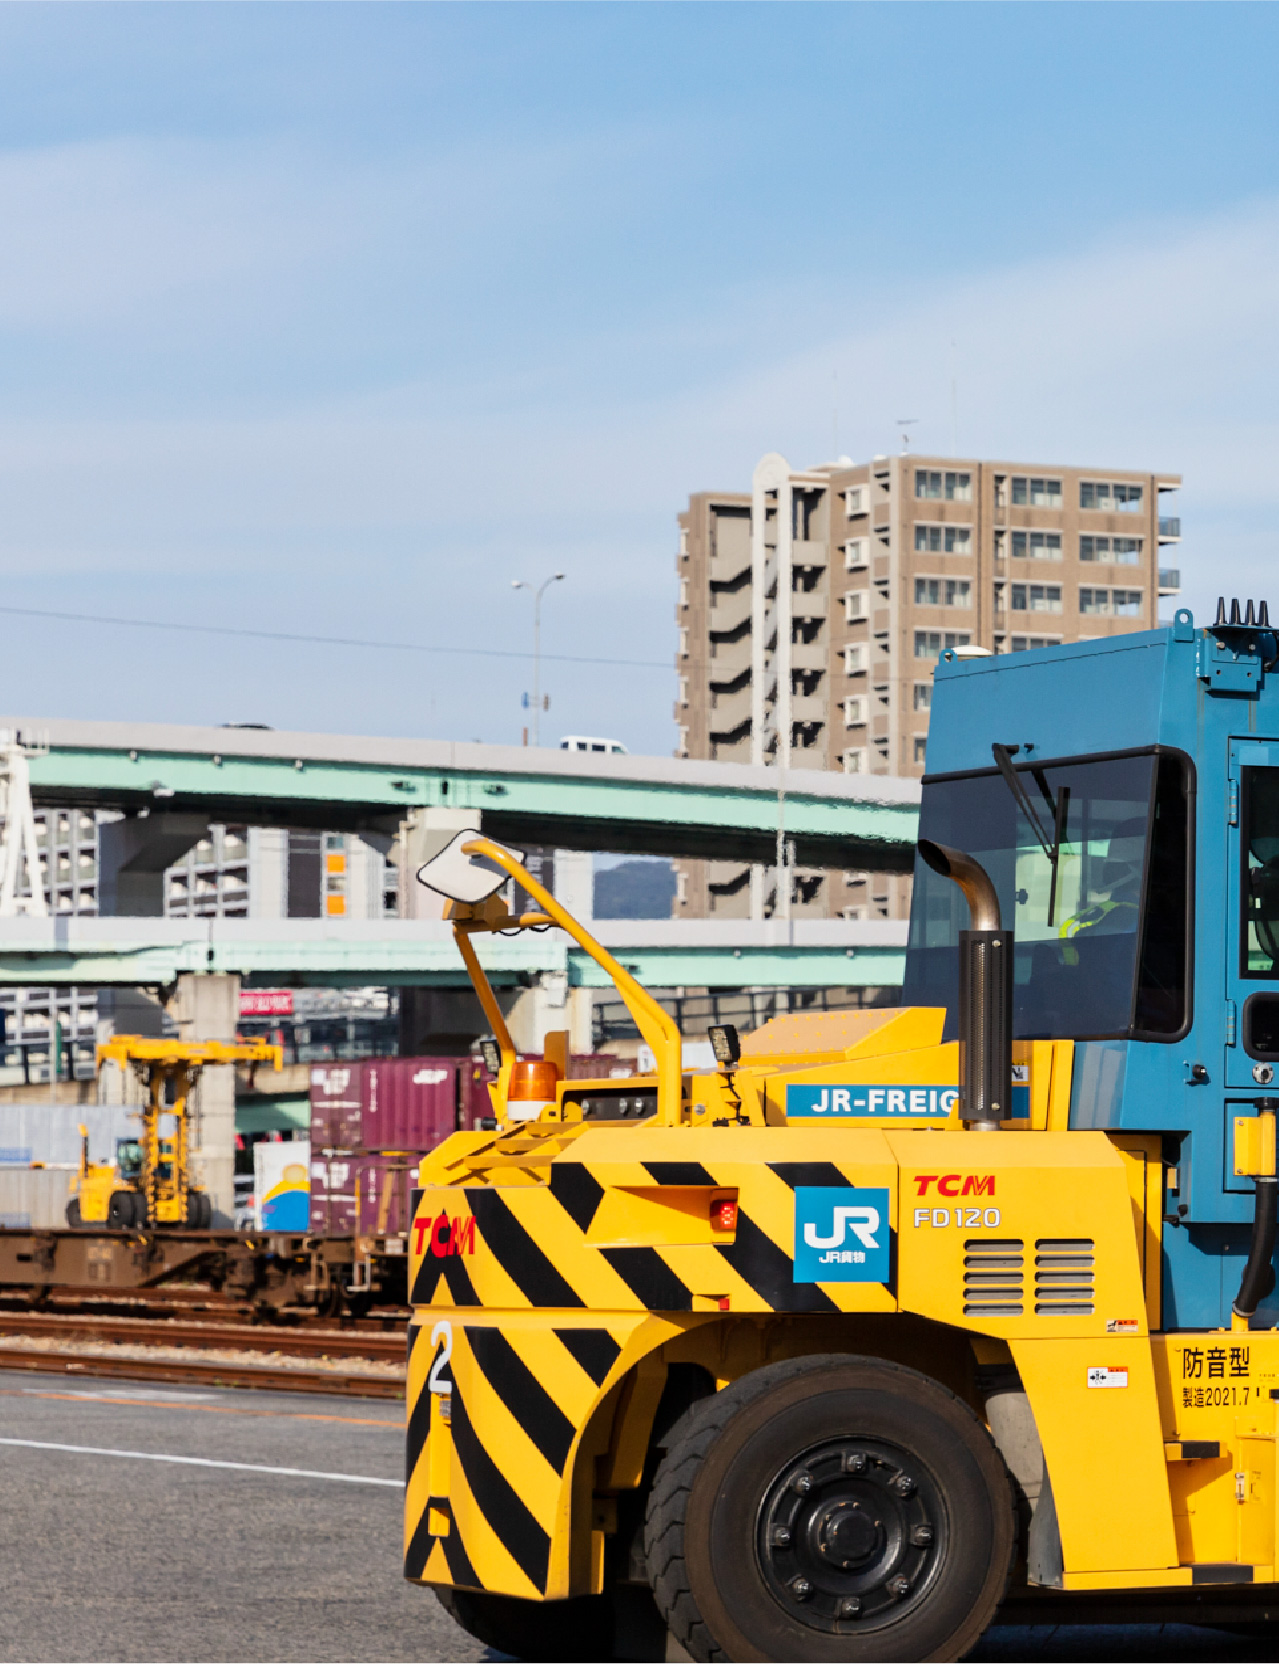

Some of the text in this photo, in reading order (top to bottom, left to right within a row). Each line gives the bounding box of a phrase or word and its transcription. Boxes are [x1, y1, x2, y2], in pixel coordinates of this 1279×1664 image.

[811, 1088, 961, 1113] JR-FREIG
[913, 1174, 996, 1196] TCM
[414, 1214, 477, 1259] TCM
[803, 1205, 880, 1249] JR
[428, 1320, 453, 1391] 2
[1183, 1346, 1250, 1380] 防音型
